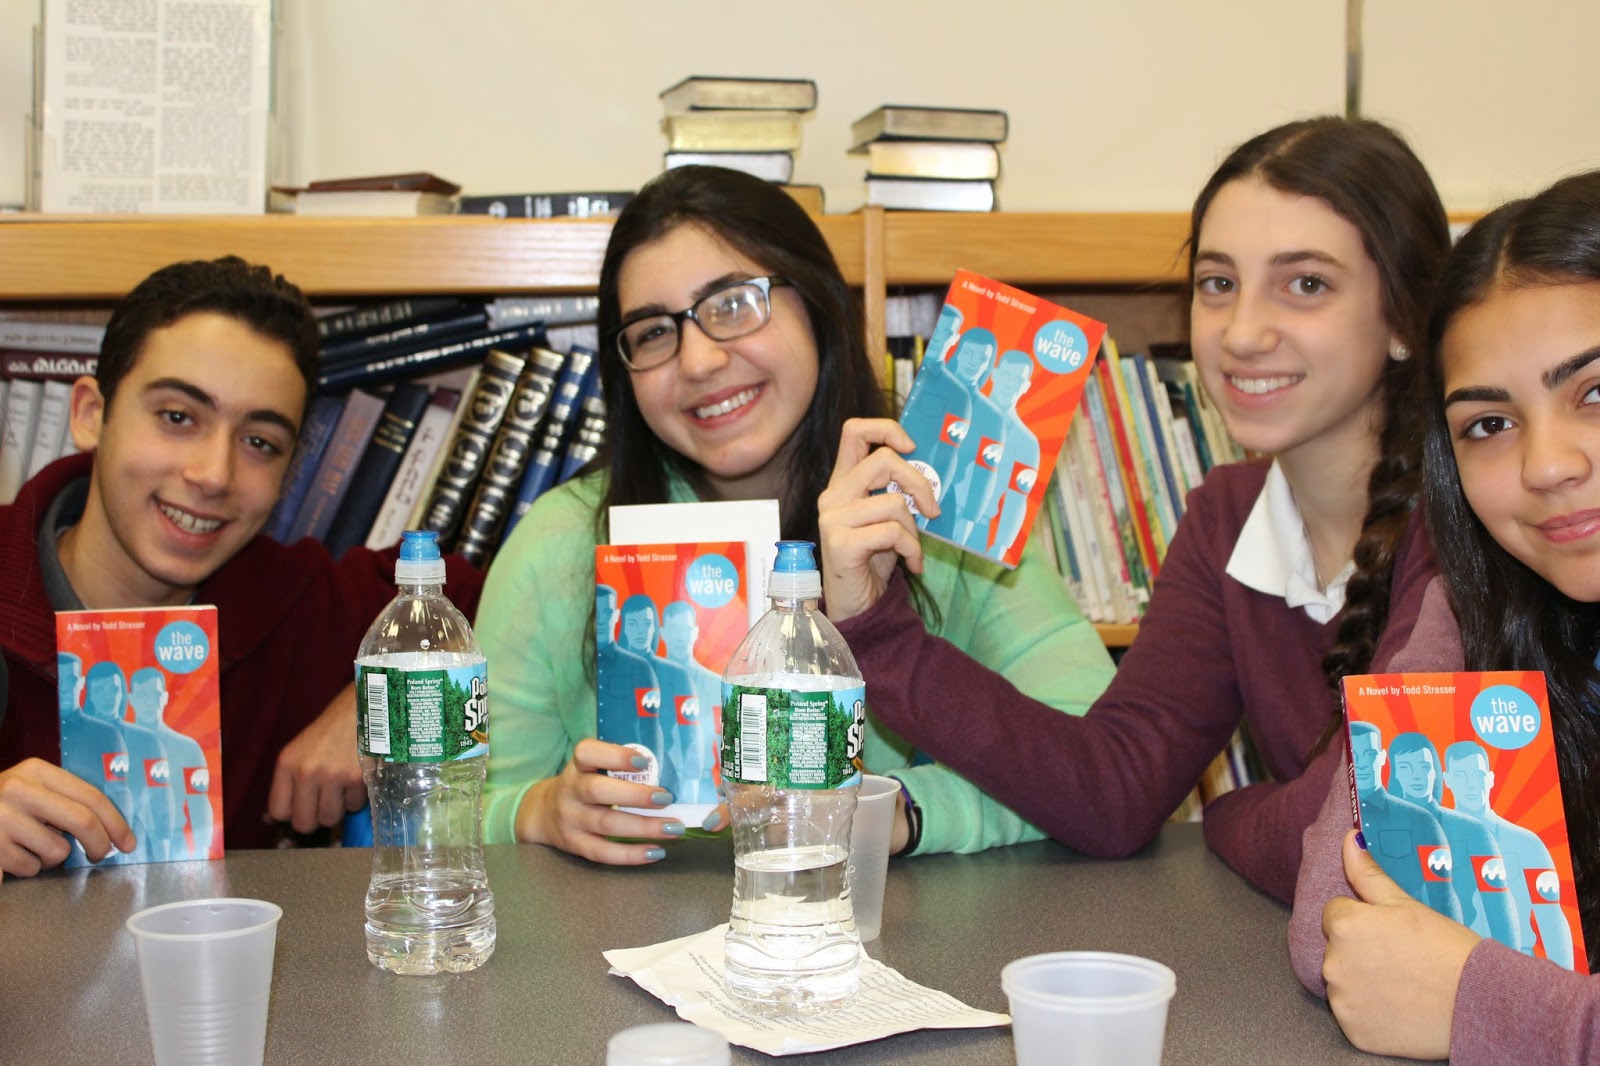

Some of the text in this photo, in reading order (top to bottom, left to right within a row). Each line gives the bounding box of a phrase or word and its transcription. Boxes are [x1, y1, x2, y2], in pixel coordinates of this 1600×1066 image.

[968, 282, 987, 296] Novel
[986, 288, 995, 300] by
[995, 291, 1011, 305] Todd
[1010, 297, 1037, 315] Strasser
[1054, 328, 1075, 348] the
[1037, 337, 1082, 367] wave
[609, 554, 627, 563] Novel
[627, 554, 635, 564] by
[635, 553, 651, 563] Todd
[651, 552, 678, 562] Strasser
[702, 564, 722, 579] the
[690, 577, 735, 595] wave
[73, 622, 92, 631] Novel
[92, 622, 101, 632] by
[101, 621, 118, 630] Todd
[118, 620, 146, 630] Strasser
[171, 631, 192, 645] the
[158, 643, 204, 662] wave
[1359, 684, 1457, 696] A Novel by Todd Strasser
[1491, 697, 1518, 714] the
[1476, 714, 1536, 734] wave
[631, 773, 650, 782] WENT
[842, 767, 854, 775] 1845
